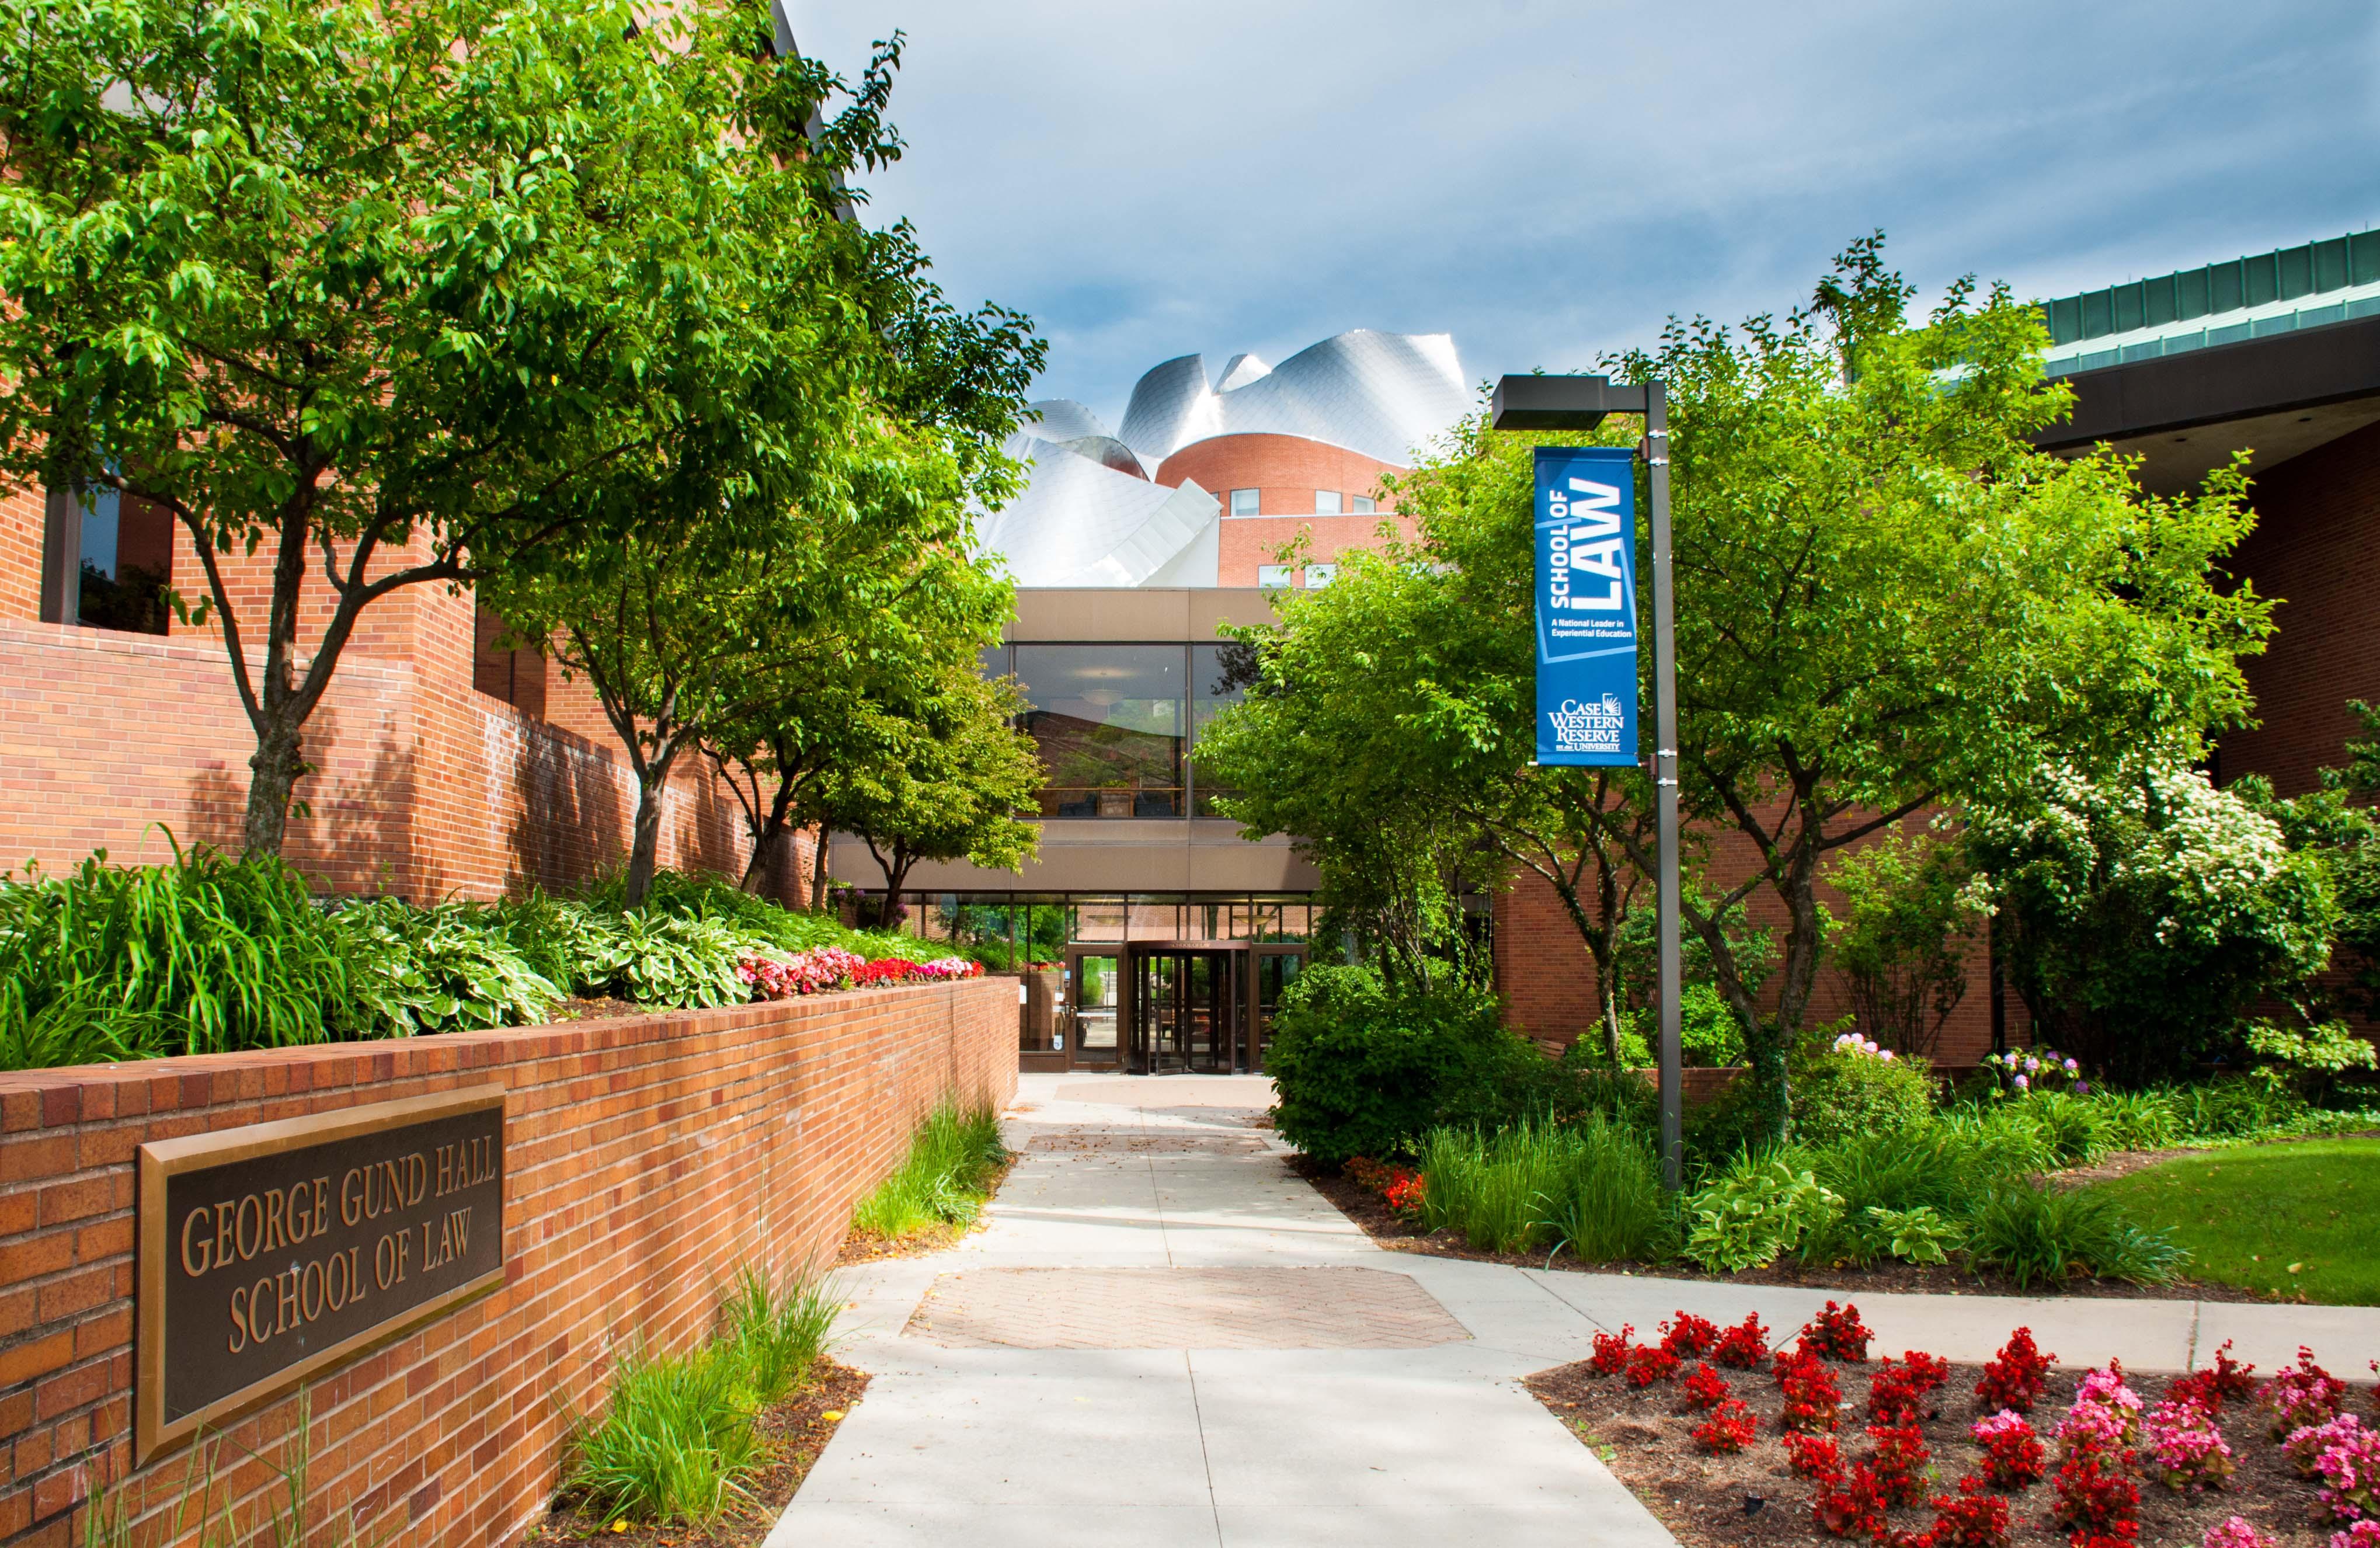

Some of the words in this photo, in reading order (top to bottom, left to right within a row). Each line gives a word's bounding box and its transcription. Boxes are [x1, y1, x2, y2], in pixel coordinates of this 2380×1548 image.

[1549, 490, 1568, 517] OF
[1569, 478, 1622, 610] LAW
[1550, 524, 1570, 609] SCHOOL
[1558, 619, 1589, 627] National
[1551, 628, 1595, 638] Experiential
[1596, 629, 1632, 638] Education
[1561, 699, 1602, 716] CASE
[1547, 712, 1624, 729] WESTERN
[1556, 726, 1620, 745] RESERVE
[1574, 743, 1620, 751] UNIVERSITY
[180, 1176, 330, 1278] GEORGE
[340, 1152, 427, 1227] GUND
[435, 1135, 496, 1198] HALL
[228, 1246, 366, 1354] SCHOOL
[375, 1228, 410, 1290] OF
[422, 1206, 472, 1272] LAW
